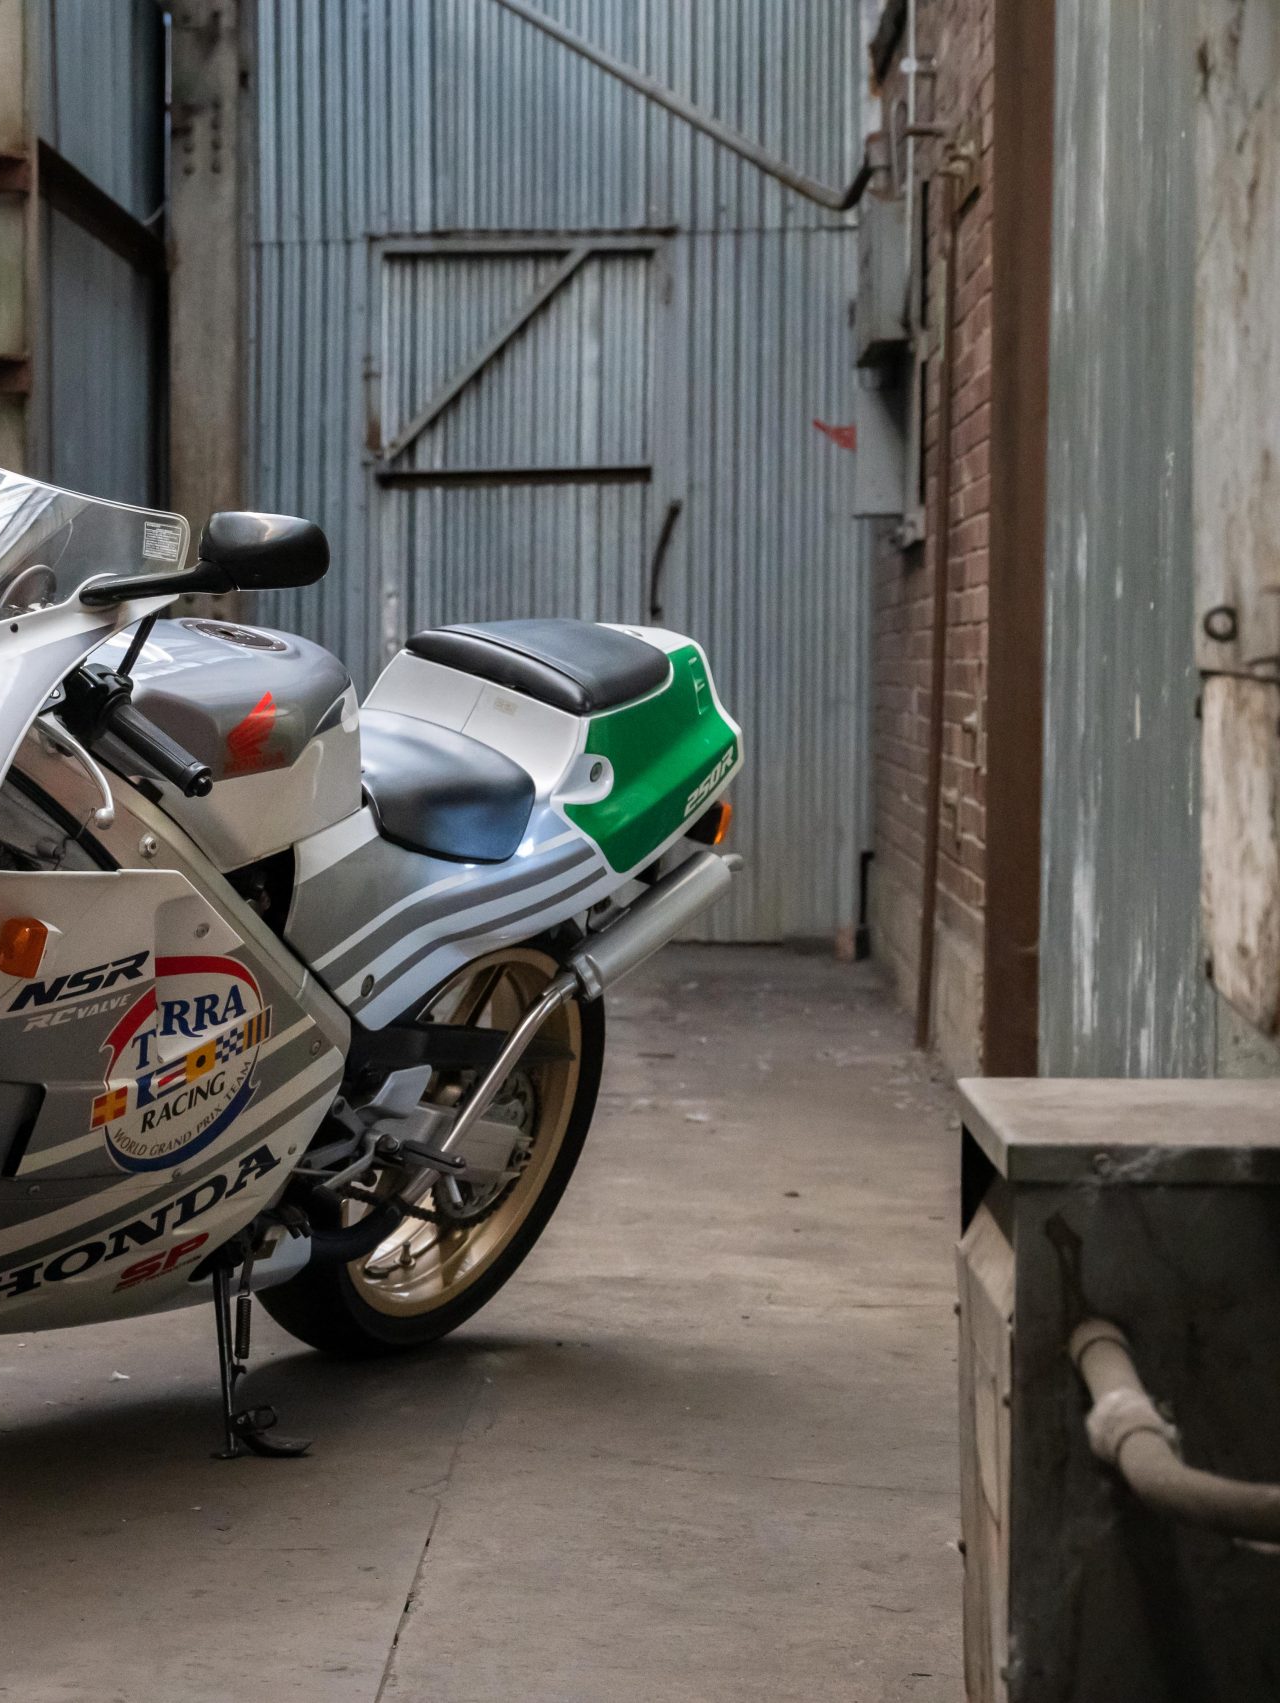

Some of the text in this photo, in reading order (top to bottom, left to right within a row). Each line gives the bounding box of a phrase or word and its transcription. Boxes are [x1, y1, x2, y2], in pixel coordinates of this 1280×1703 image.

[684, 745, 734, 817] 250R
[7, 950, 150, 1012] NSR
[22, 994, 131, 1032] RC VALVE
[114, 1061, 252, 1157] WORLD GRAND PRIX TEAM
[141, 1071, 225, 1134] RACING
[115, 1231, 210, 1288] SP
